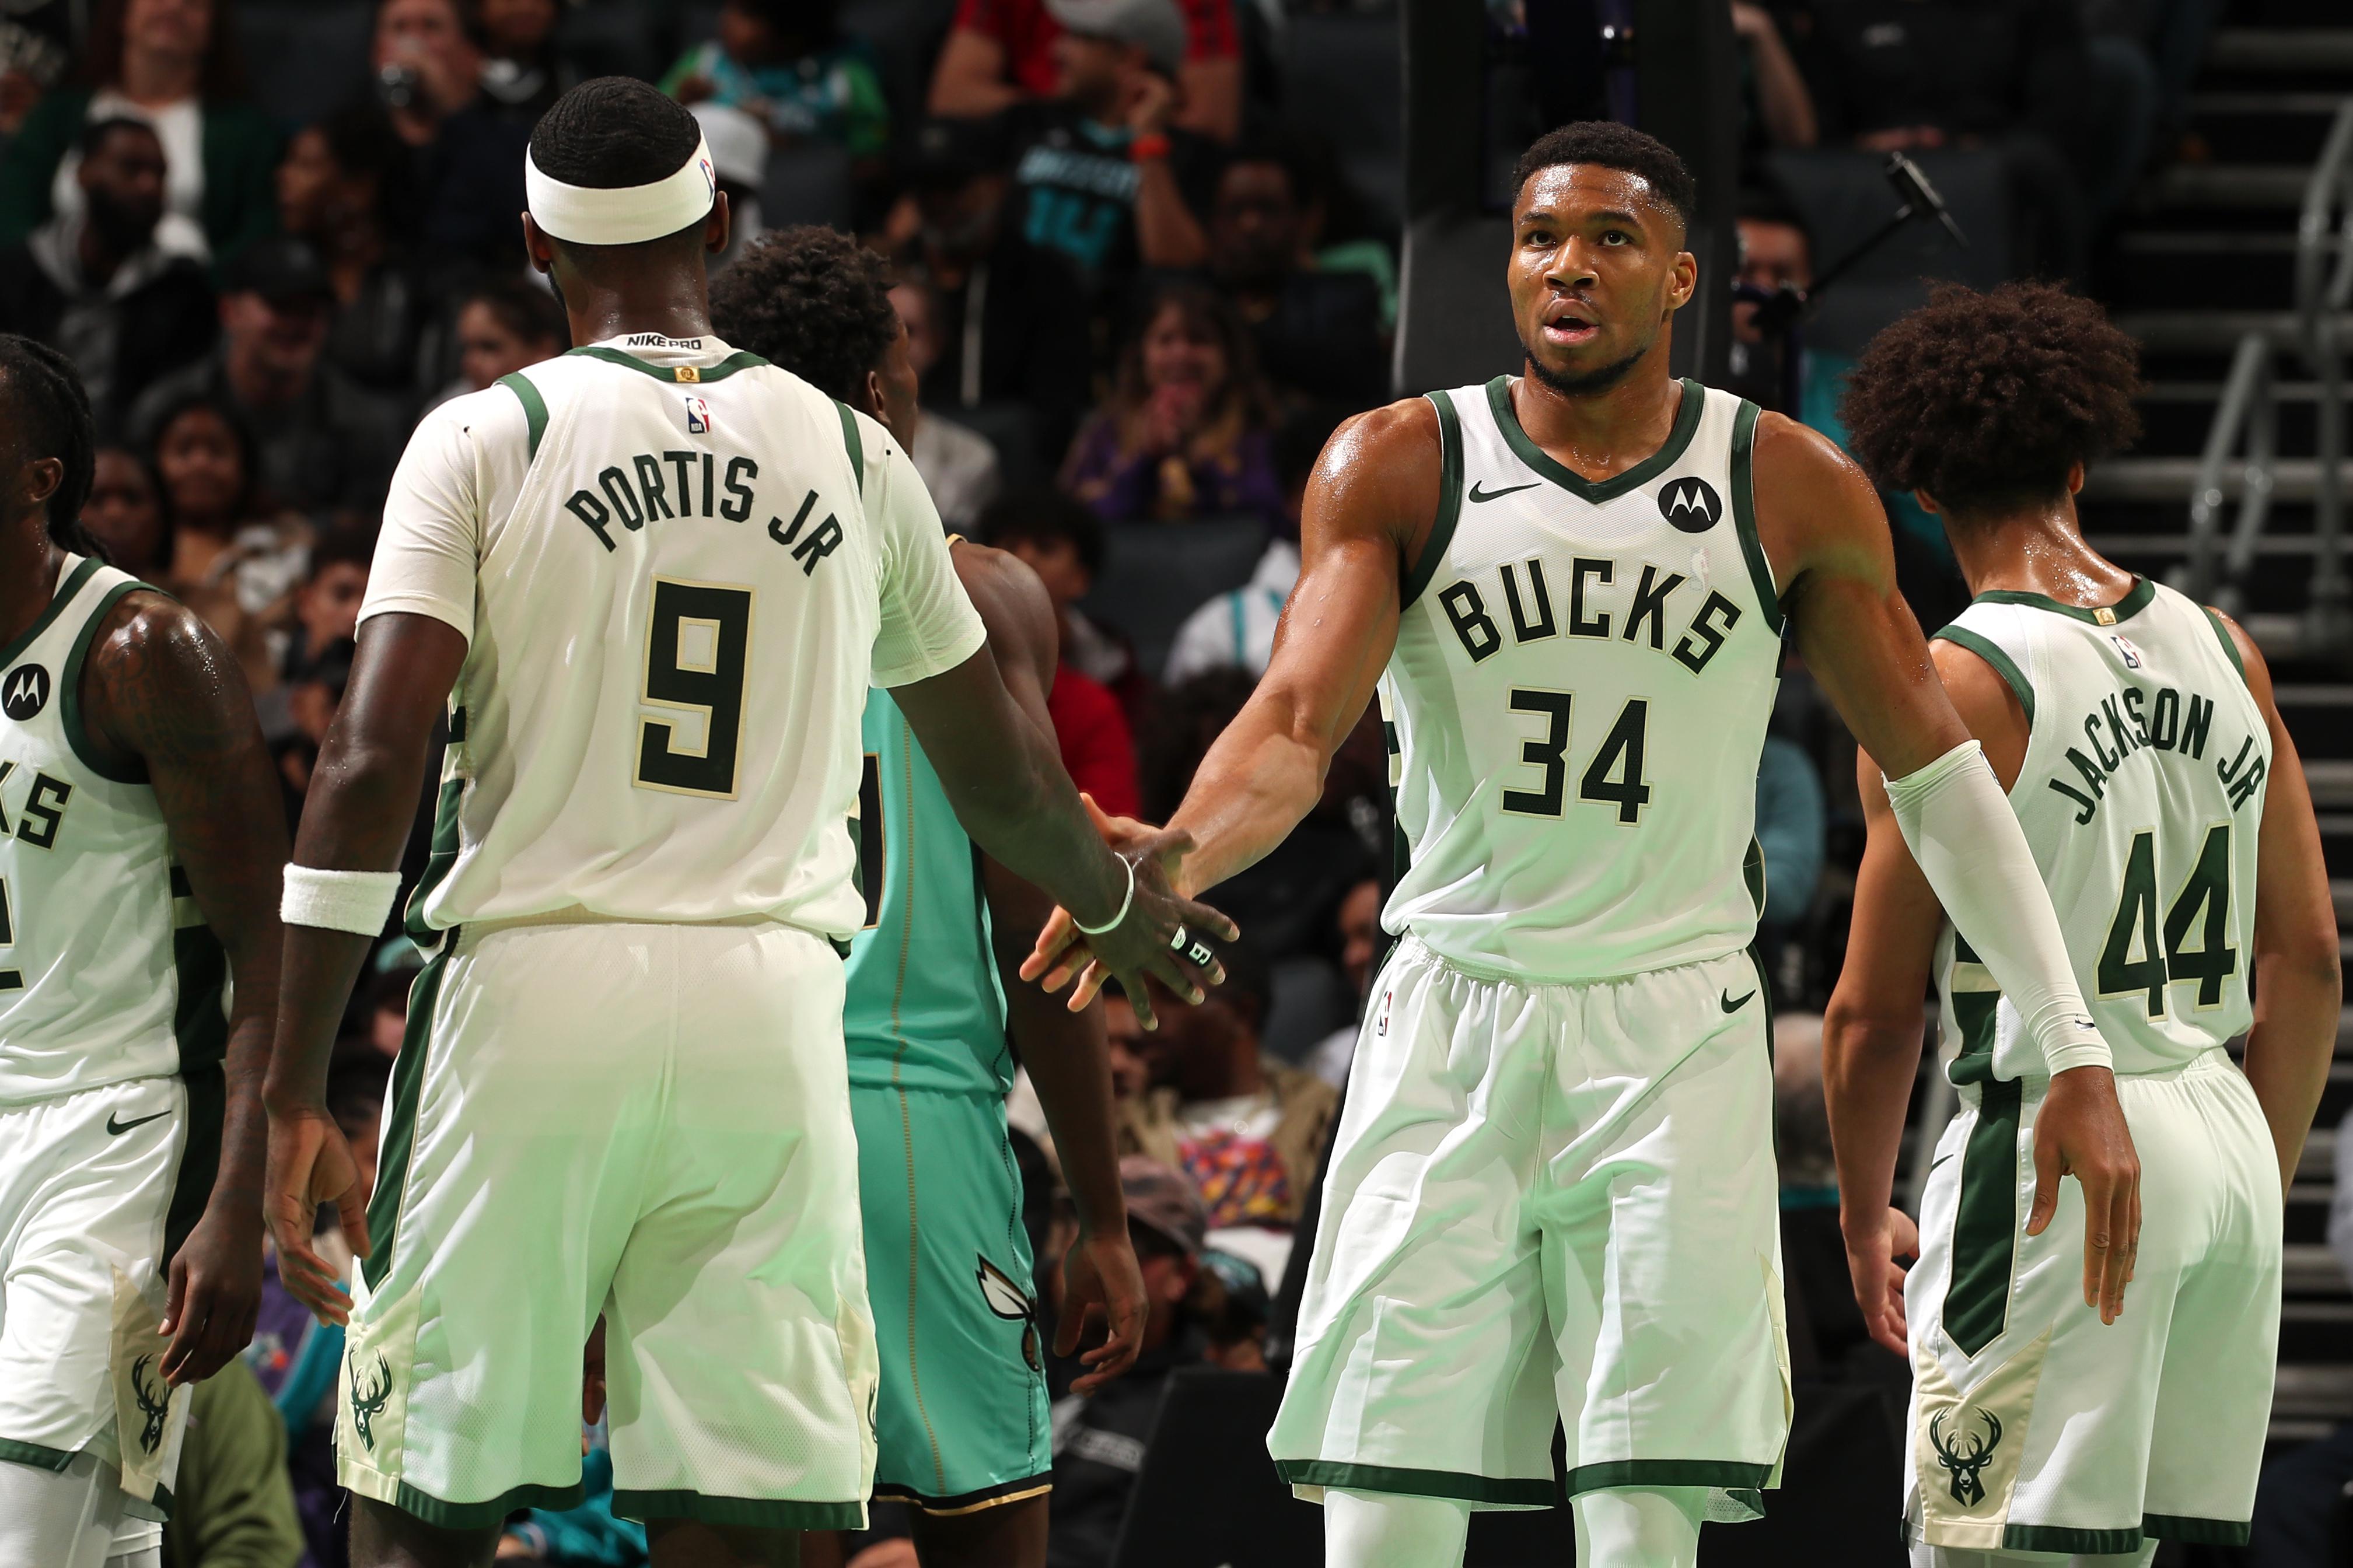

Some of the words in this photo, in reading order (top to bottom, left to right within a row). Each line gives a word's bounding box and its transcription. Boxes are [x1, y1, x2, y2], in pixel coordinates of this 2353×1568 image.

[627, 334, 667, 347] NIKE
[669, 340, 701, 350] PRO
[564, 450, 758, 553] PORTIS
[767, 489, 844, 577] JR
[1435, 555, 1744, 678] BUCKS
[631, 573, 756, 802] 9
[1498, 684, 1655, 828] 34
[2048, 687, 2214, 825] JACKSON
[2216, 734, 2266, 813] JR
[2092, 818, 2240, 1024] 44
